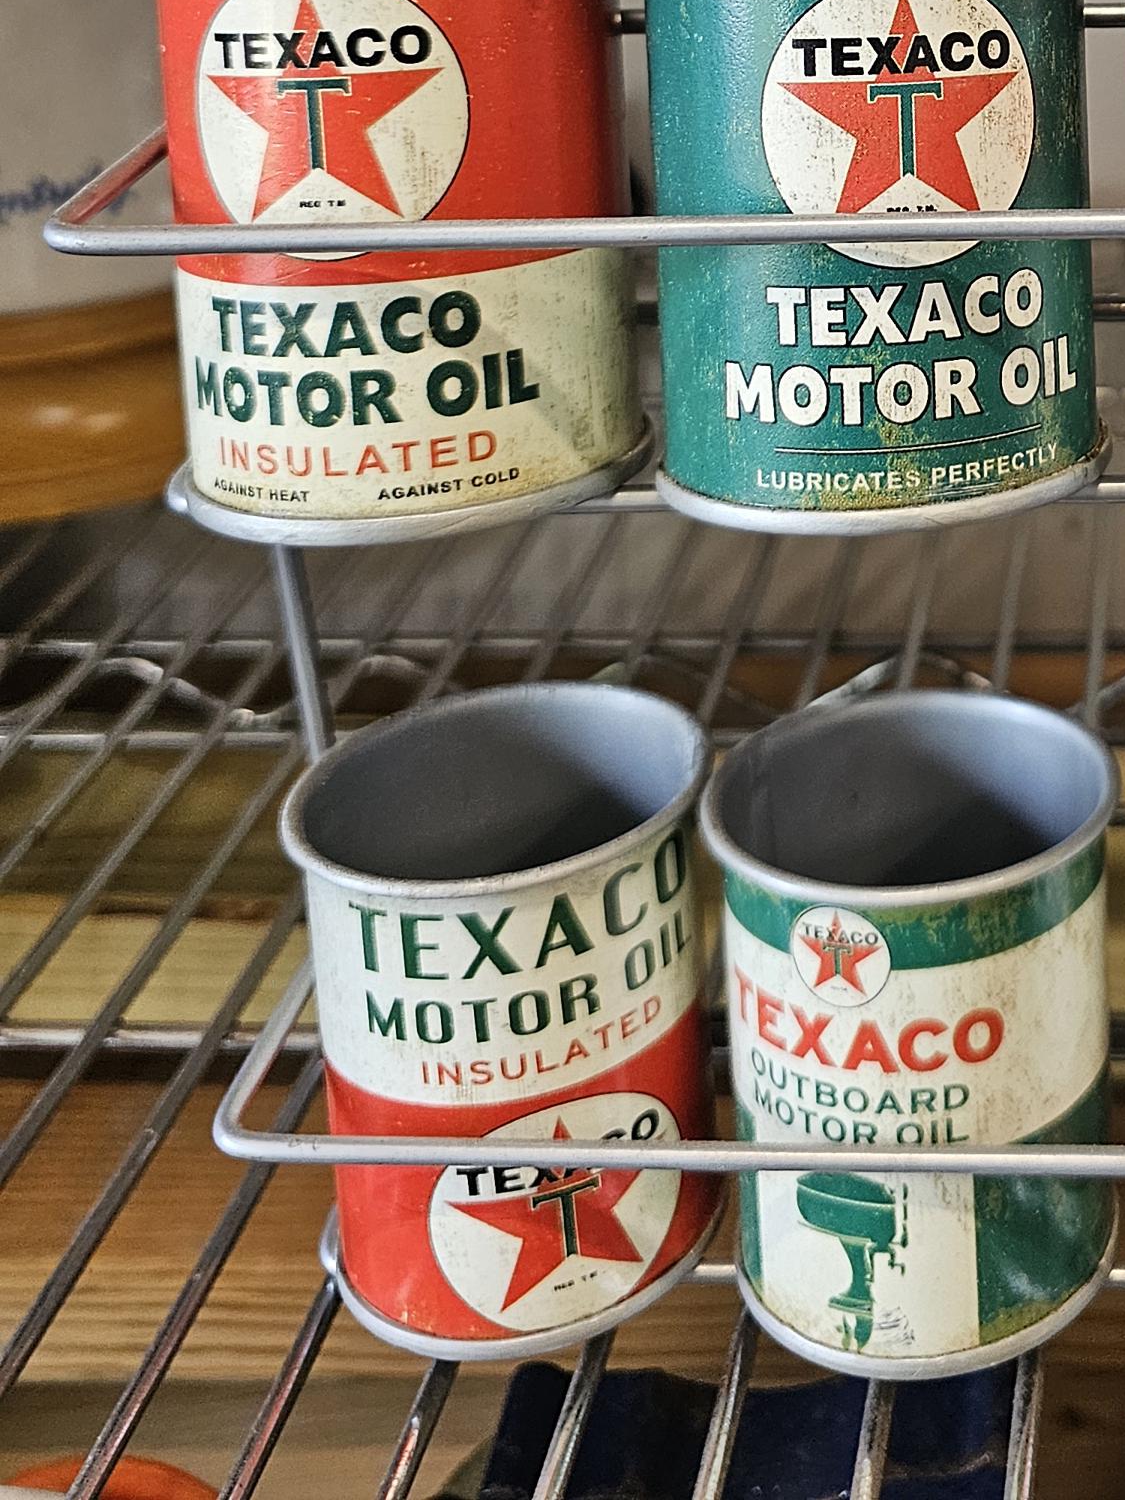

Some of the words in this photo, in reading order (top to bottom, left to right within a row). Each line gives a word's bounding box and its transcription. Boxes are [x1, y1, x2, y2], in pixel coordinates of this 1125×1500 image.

[214, 24, 432, 69] TEXACO
[792, 31, 1010, 76] TEXACO
[211, 291, 481, 358] TEXACO
[766, 269, 1043, 348] TEXACO
[195, 355, 402, 427] MOTOR
[426, 347, 540, 418] OIL
[725, 361, 980, 426] MOTOR
[1000, 336, 1077, 407] OIL
[219, 429, 498, 478] INSULATED
[378, 478, 464, 501] AGAINST
[471, 467, 520, 488] COLD
[756, 468, 921, 491] LUBRICATES
[931, 443, 1058, 486] PERFECTLY
[214, 477, 262, 500] AGAINST
[269, 489, 310, 503] HEAT
[349, 830, 688, 981] TEXACO
[802, 921, 879, 946] TEXACO
[366, 972, 601, 1045] MOTOR
[624, 914, 692, 991] OIL
[421, 995, 663, 1086] INSULATED
[734, 966, 1005, 1074] TEXACO
[751, 1047, 970, 1114] OUTBOARD
[754, 1078, 878, 1144] MOTOR
[896, 1117, 970, 1144] OIL
